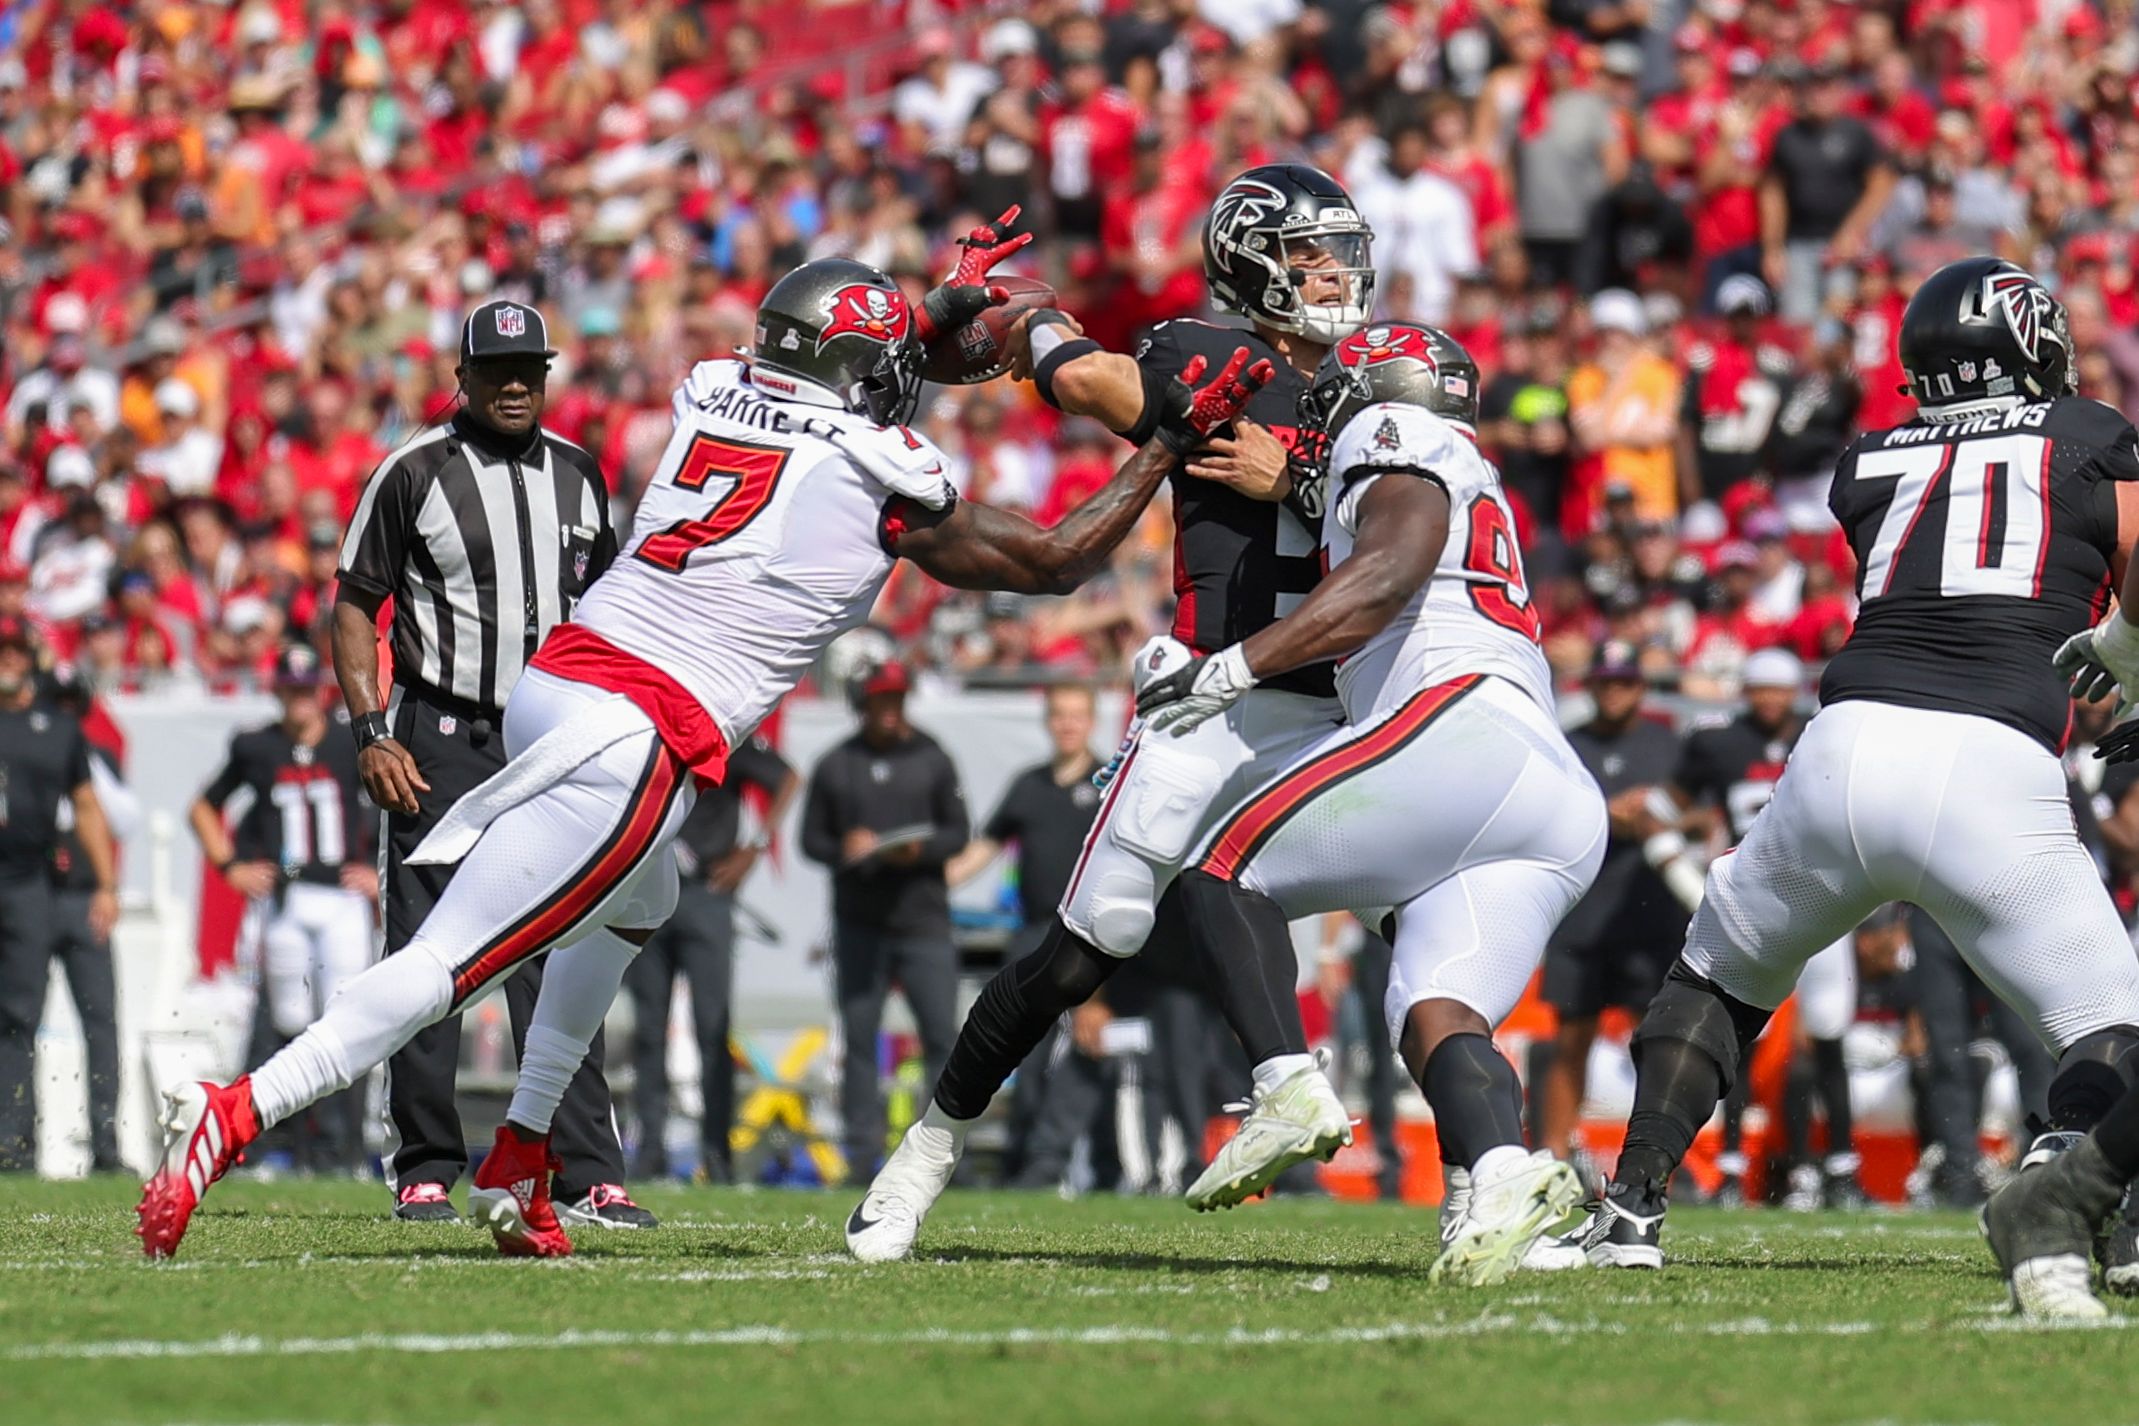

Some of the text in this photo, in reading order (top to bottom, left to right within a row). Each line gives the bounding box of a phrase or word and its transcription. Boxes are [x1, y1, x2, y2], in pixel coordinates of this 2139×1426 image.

[1333, 210, 1352, 220] ATL
[499, 319, 523, 333] NFL
[1918, 373, 1955, 399] 70
[1883, 402, 2052, 447] MATTHEWS
[631, 431, 794, 574] 7
[1854, 434, 2054, 602] 70
[271, 778, 345, 866] 11
